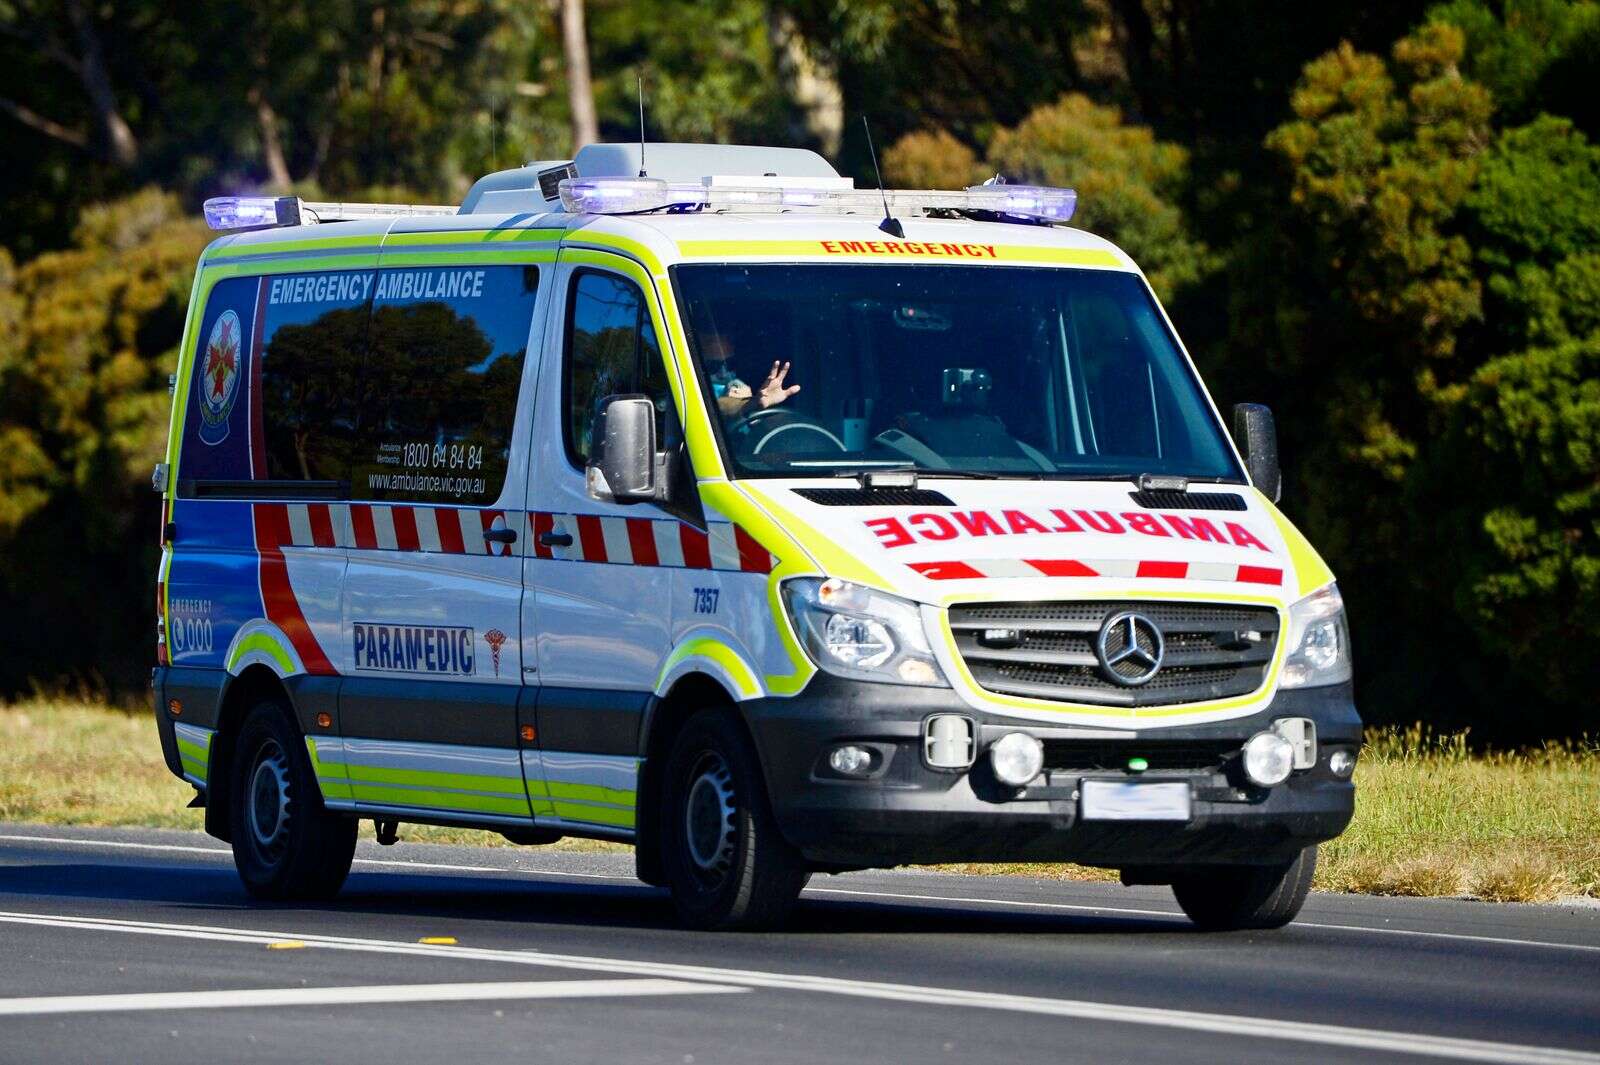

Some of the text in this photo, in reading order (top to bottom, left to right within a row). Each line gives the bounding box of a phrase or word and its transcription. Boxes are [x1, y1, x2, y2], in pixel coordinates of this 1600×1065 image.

[820, 241, 997, 258] EMERGENCY
[269, 271, 485, 304] EMERGENCY AMBULANCE
[403, 443, 483, 470] 1800 64 84 84
[368, 472, 486, 497] www.ambulance.vic.gov.au
[171, 599, 213, 613] EMERGENCY
[693, 588, 719, 614] 7357
[187, 618, 213, 651] 000
[354, 625, 473, 674] PARAMEDIC
